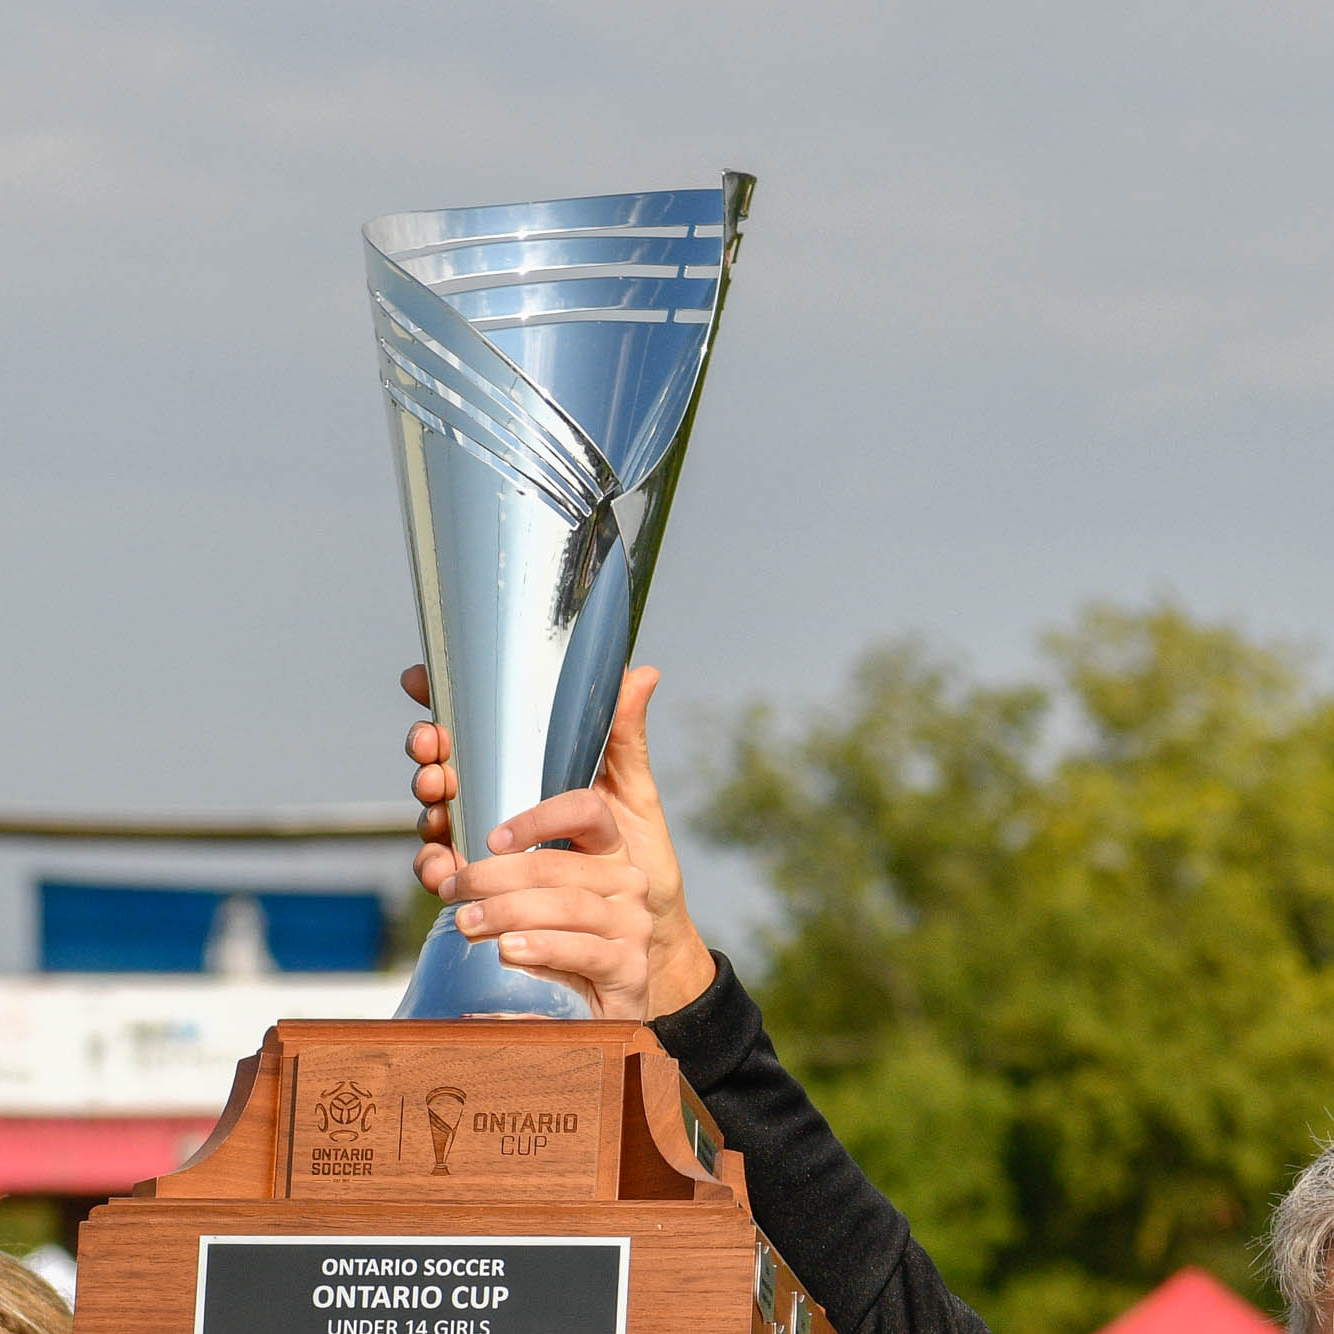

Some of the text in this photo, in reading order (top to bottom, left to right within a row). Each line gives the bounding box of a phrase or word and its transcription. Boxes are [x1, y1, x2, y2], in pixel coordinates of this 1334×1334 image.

[473, 1112, 578, 1134] ONTARIO
[312, 1148, 374, 1161] ONTARIO
[501, 1135, 547, 1156] CUP
[311, 1162, 372, 1176] SOCCER
[321, 1258, 505, 1277] ONTARIO SOCCER
[312, 1285, 509, 1310] ONTARIO CUP
